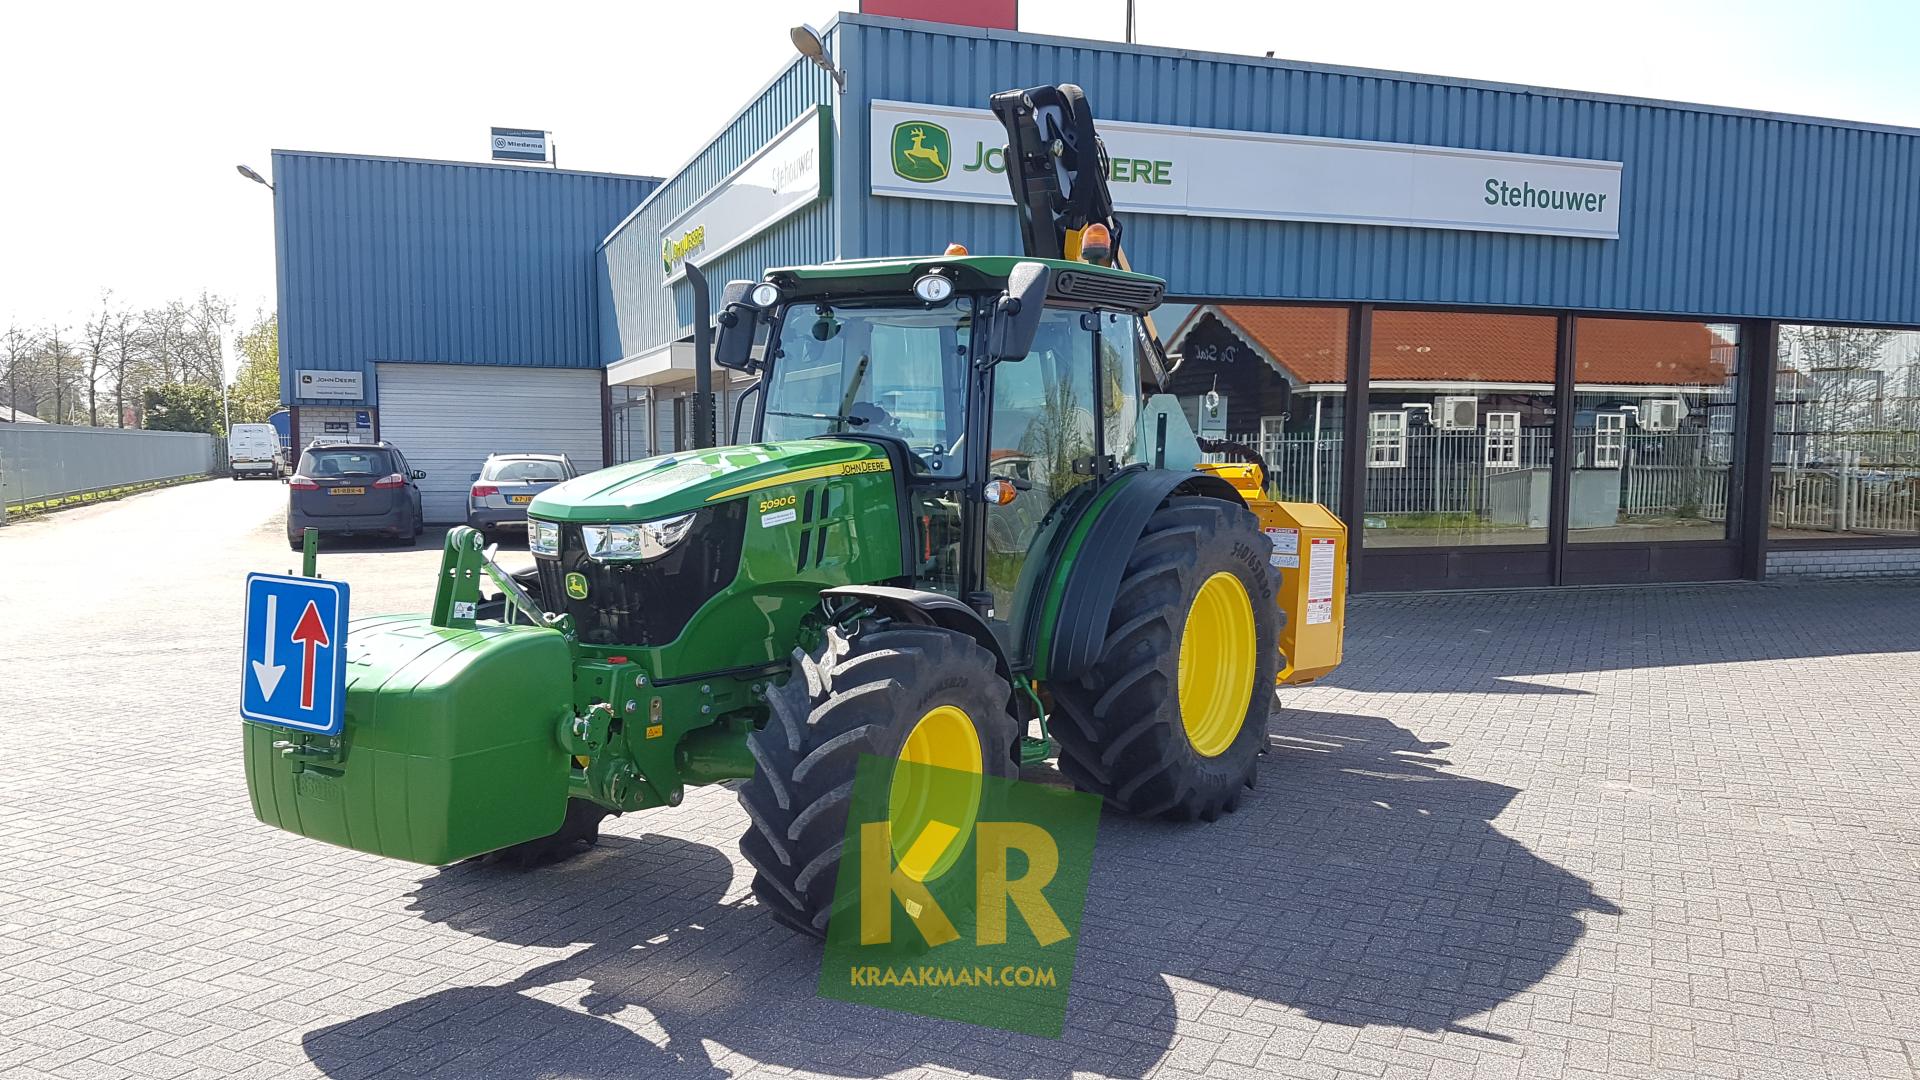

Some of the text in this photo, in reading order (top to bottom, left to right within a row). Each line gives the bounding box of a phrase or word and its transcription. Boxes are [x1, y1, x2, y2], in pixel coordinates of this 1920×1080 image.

[1104, 157, 1173, 186] ERE
[1484, 177, 1607, 213] Stehouwer
[841, 461, 885, 475] JOHN DEERE
[760, 495, 796, 513] 5090 G
